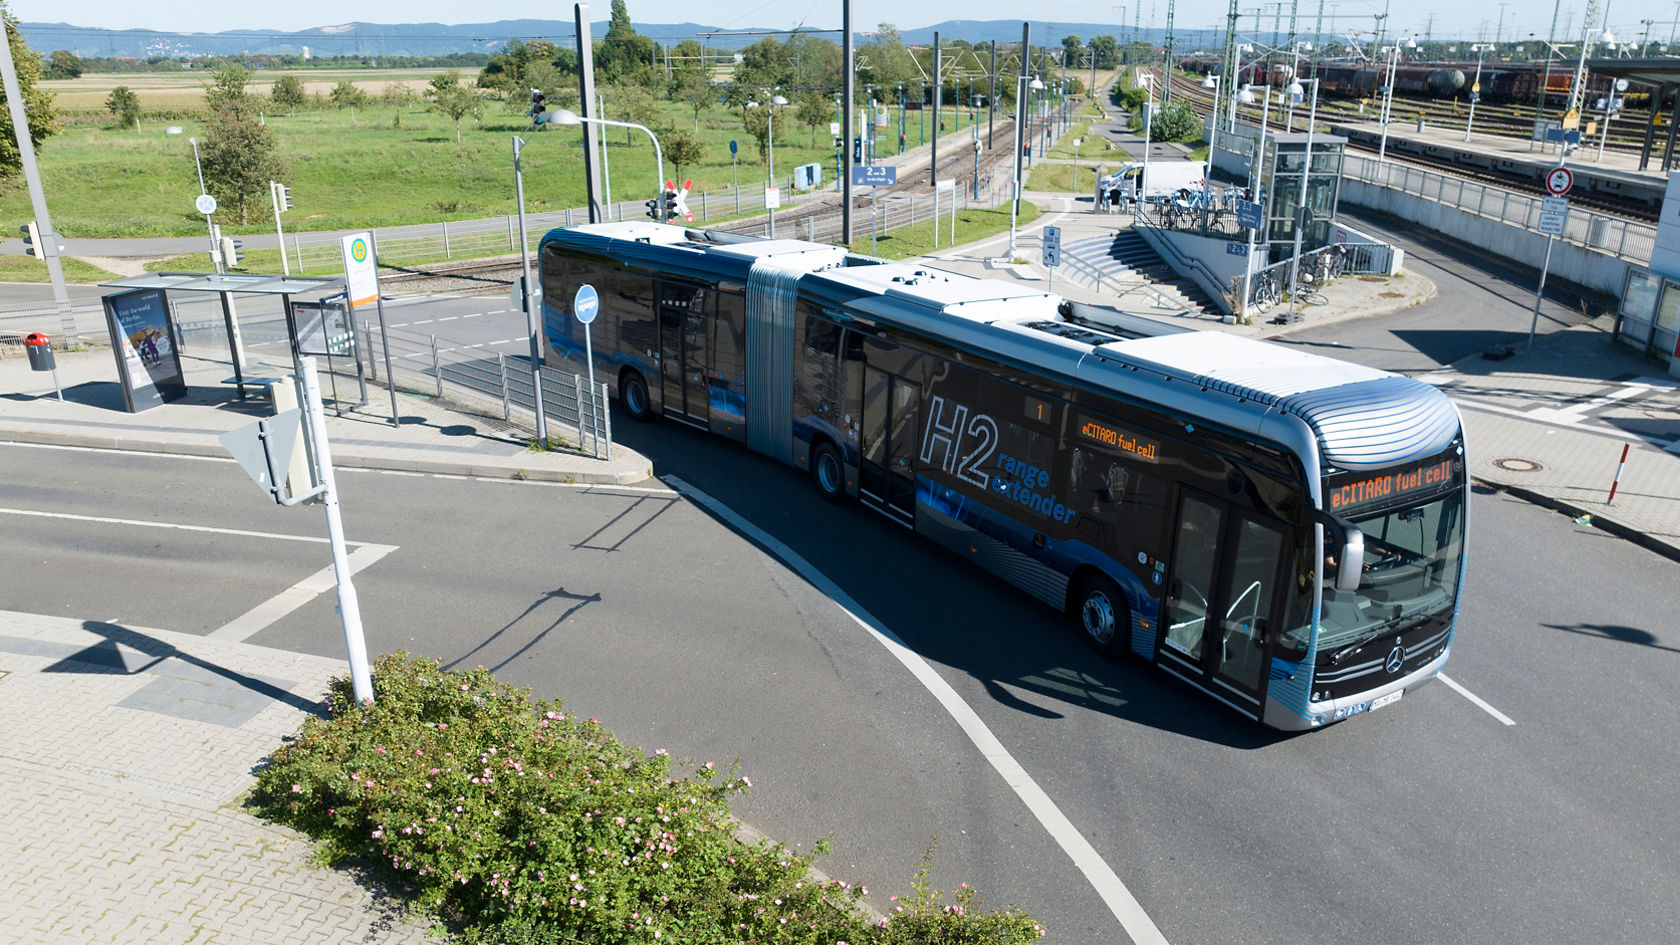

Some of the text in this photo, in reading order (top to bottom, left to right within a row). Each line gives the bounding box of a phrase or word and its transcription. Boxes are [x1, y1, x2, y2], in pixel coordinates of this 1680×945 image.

[867, 167, 873, 176] 2
[880, 167, 886, 176] 3
[1037, 404, 1043, 420] 1
[920, 395, 999, 490] H2
[1082, 422, 1155, 460] eCITARO fuel cell
[996, 453, 1049, 489] range
[1332, 460, 1451, 509] eCITARO fuel cell
[991, 475, 1076, 524] extender
